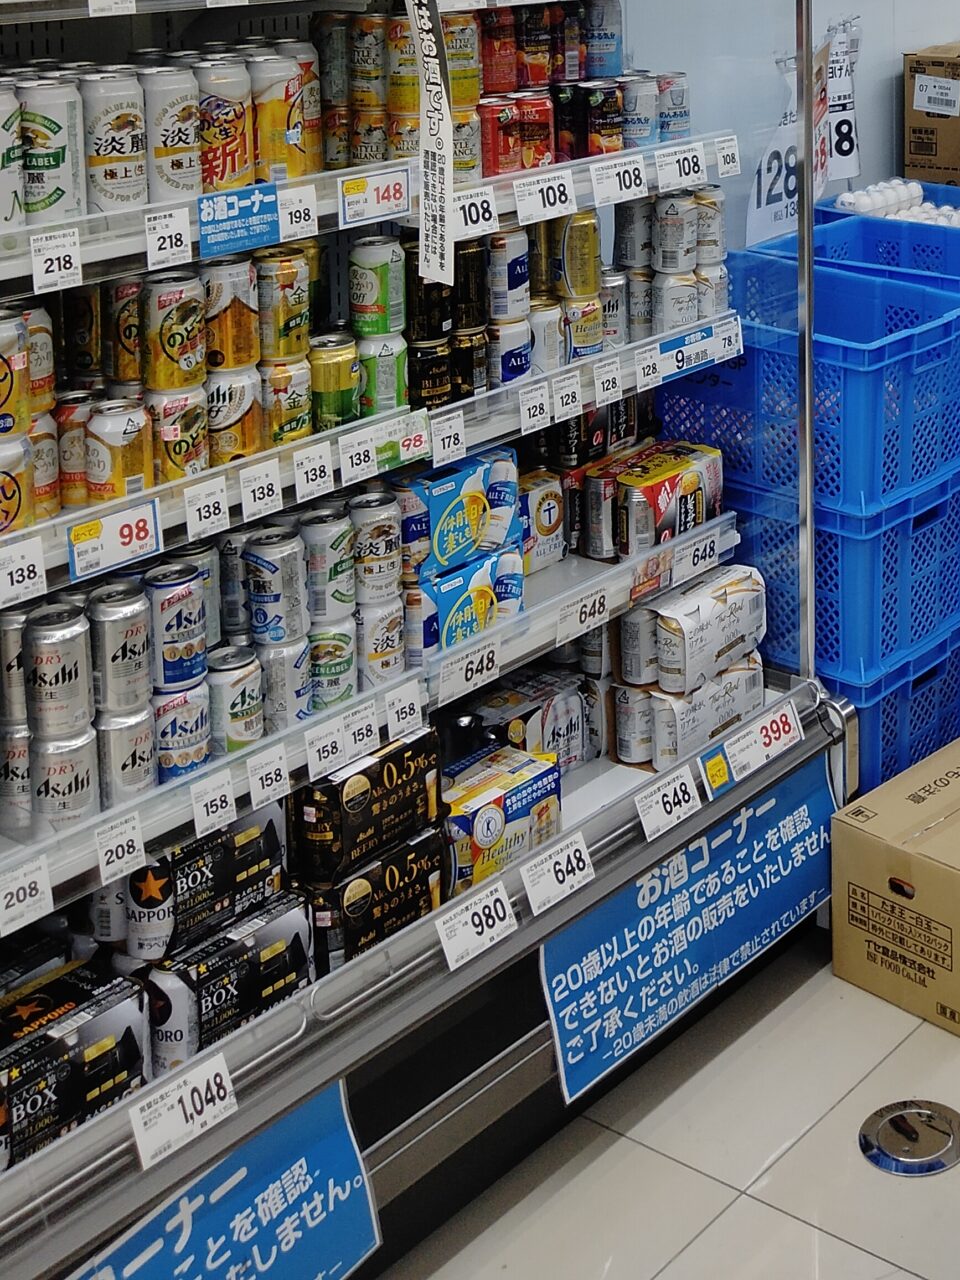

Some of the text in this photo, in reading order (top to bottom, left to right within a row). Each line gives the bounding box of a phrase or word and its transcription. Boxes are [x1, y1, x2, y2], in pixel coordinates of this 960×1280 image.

[918, 83, 928, 93] 07
[675, 154, 701, 178] 108
[721, 152, 737, 165] 108
[615, 167, 643, 191] 108
[200, 188, 276, 222] お酒コーナー
[374, 182, 404, 205] 148
[538, 183, 569, 209] 108
[287, 207, 312, 225] 198
[459, 199, 493, 226] 108
[157, 232, 184, 252] 218
[43, 253, 74, 275] 218
[722, 335, 733, 348] 78
[641, 363, 658, 378] 128
[601, 376, 618, 392] 128
[527, 402, 545, 418] 128
[560, 391, 577, 408] 128
[401, 433, 424, 449] 98
[440, 432, 461, 450] 178
[349, 450, 371, 469] 138
[303, 465, 327, 485] 138
[250, 483, 275, 503] 138
[196, 501, 222, 522] 138
[119, 518, 150, 547] 98
[691, 539, 716, 567] 648
[7, 564, 38, 587] 138
[578, 595, 606, 625] 648
[33, 656, 62, 665] DRY
[464, 650, 496, 683] 648
[44, 690, 57, 700] 生
[395, 702, 416, 722] 158
[351, 723, 374, 745] 158
[760, 713, 792, 748] 398
[316, 740, 339, 762] 158
[47, 765, 75, 776] DRY
[258, 768, 284, 791] 158
[36, 769, 91, 798] Asahi
[202, 794, 229, 817] 158
[660, 782, 692, 817] 648
[104, 838, 137, 867] 208
[481, 830, 528, 866] Healthy
[635, 797, 777, 910] お酒コーナー
[552, 848, 587, 885] 648
[175, 863, 214, 896] BOX
[3, 880, 40, 911] 208
[551, 804, 813, 1003] 20歳以上の年齢であることを確認
[471, 897, 507, 937] 980
[864, 939, 937, 980] イセ食品株式会社
[866, 951, 879, 965] ISE
[880, 957, 901, 975] FOOD
[200, 979, 240, 1014] BOX
[12, 1001, 76, 1039] SAPPORO
[566, 960, 700, 1066] ご了承ください。
[12, 1083, 58, 1124] BOX
[178, 1072, 228, 1126] 1,048
